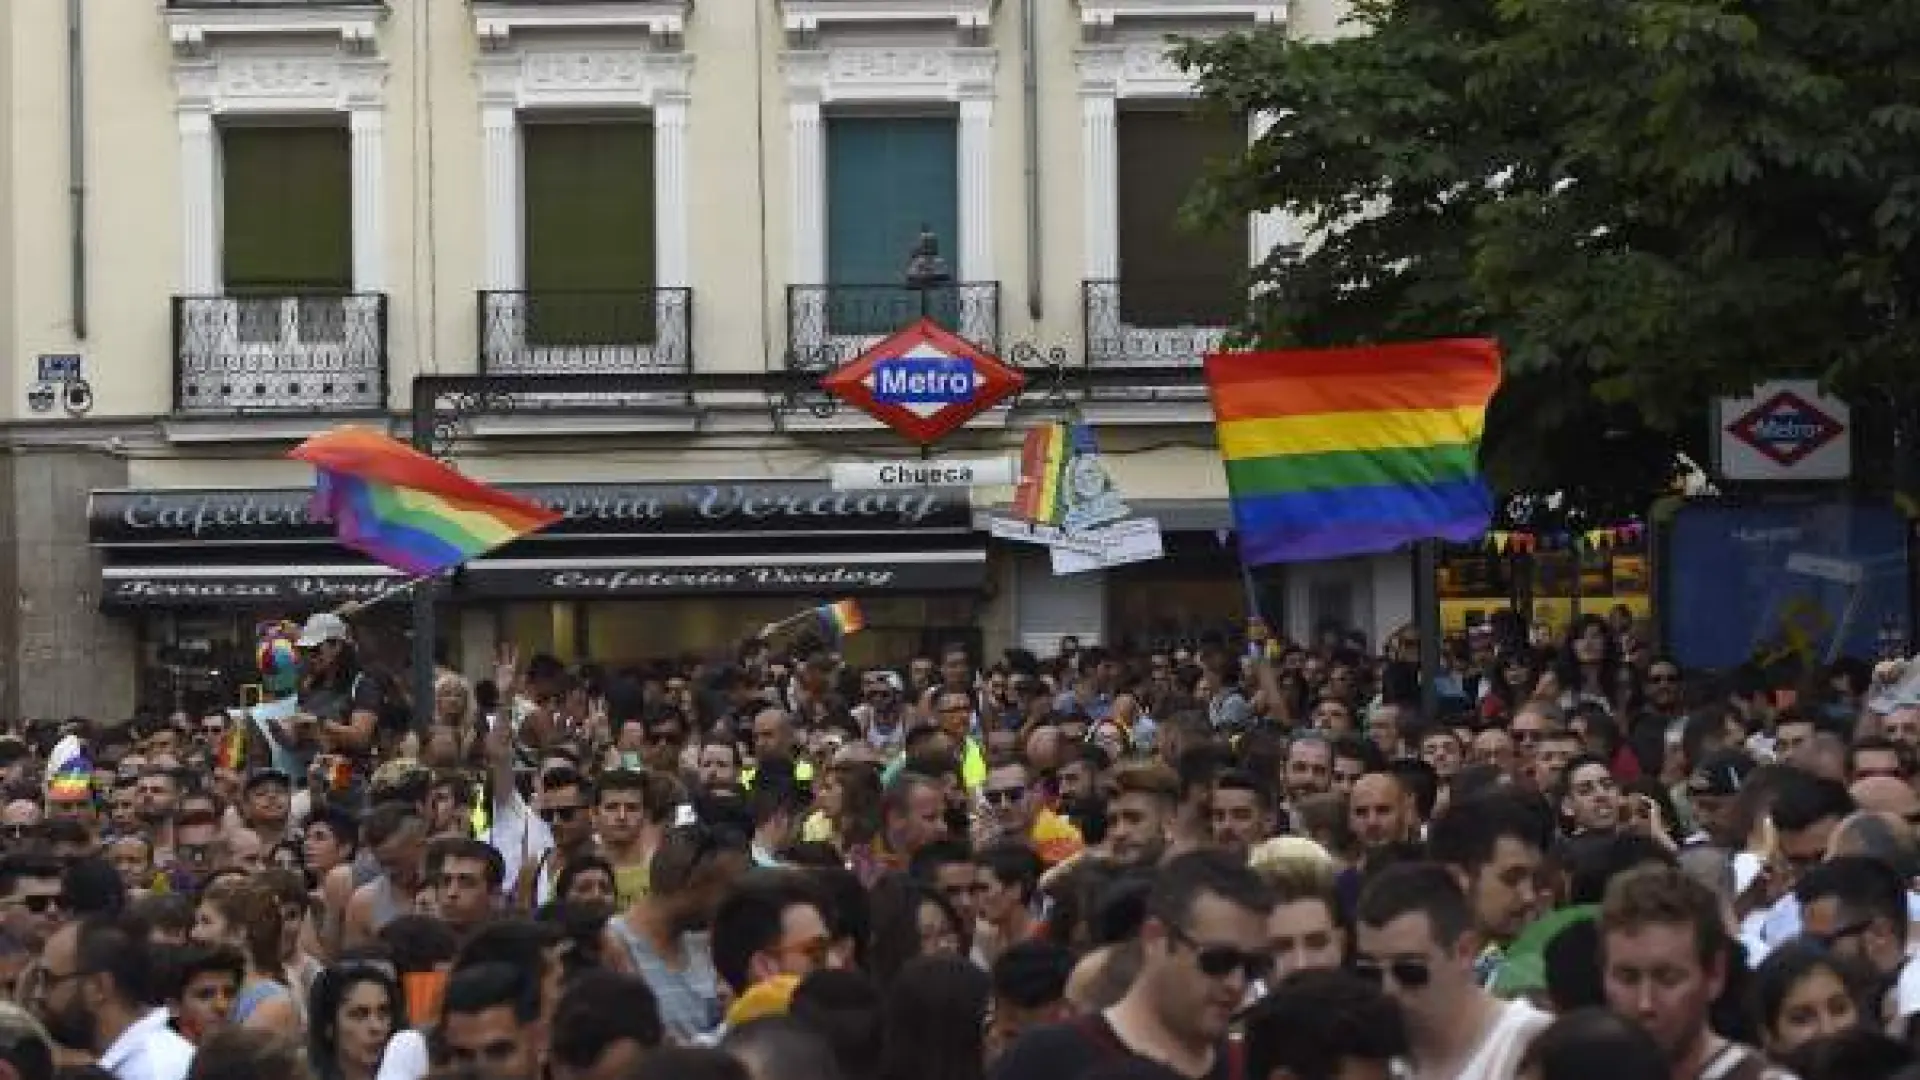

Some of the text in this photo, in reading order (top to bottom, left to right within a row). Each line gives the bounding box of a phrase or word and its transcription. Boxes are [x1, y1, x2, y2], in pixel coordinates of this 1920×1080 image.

[879, 366, 970, 395] Metro
[878, 464, 974, 485] Chueca
[123, 495, 316, 538] Cafeter
